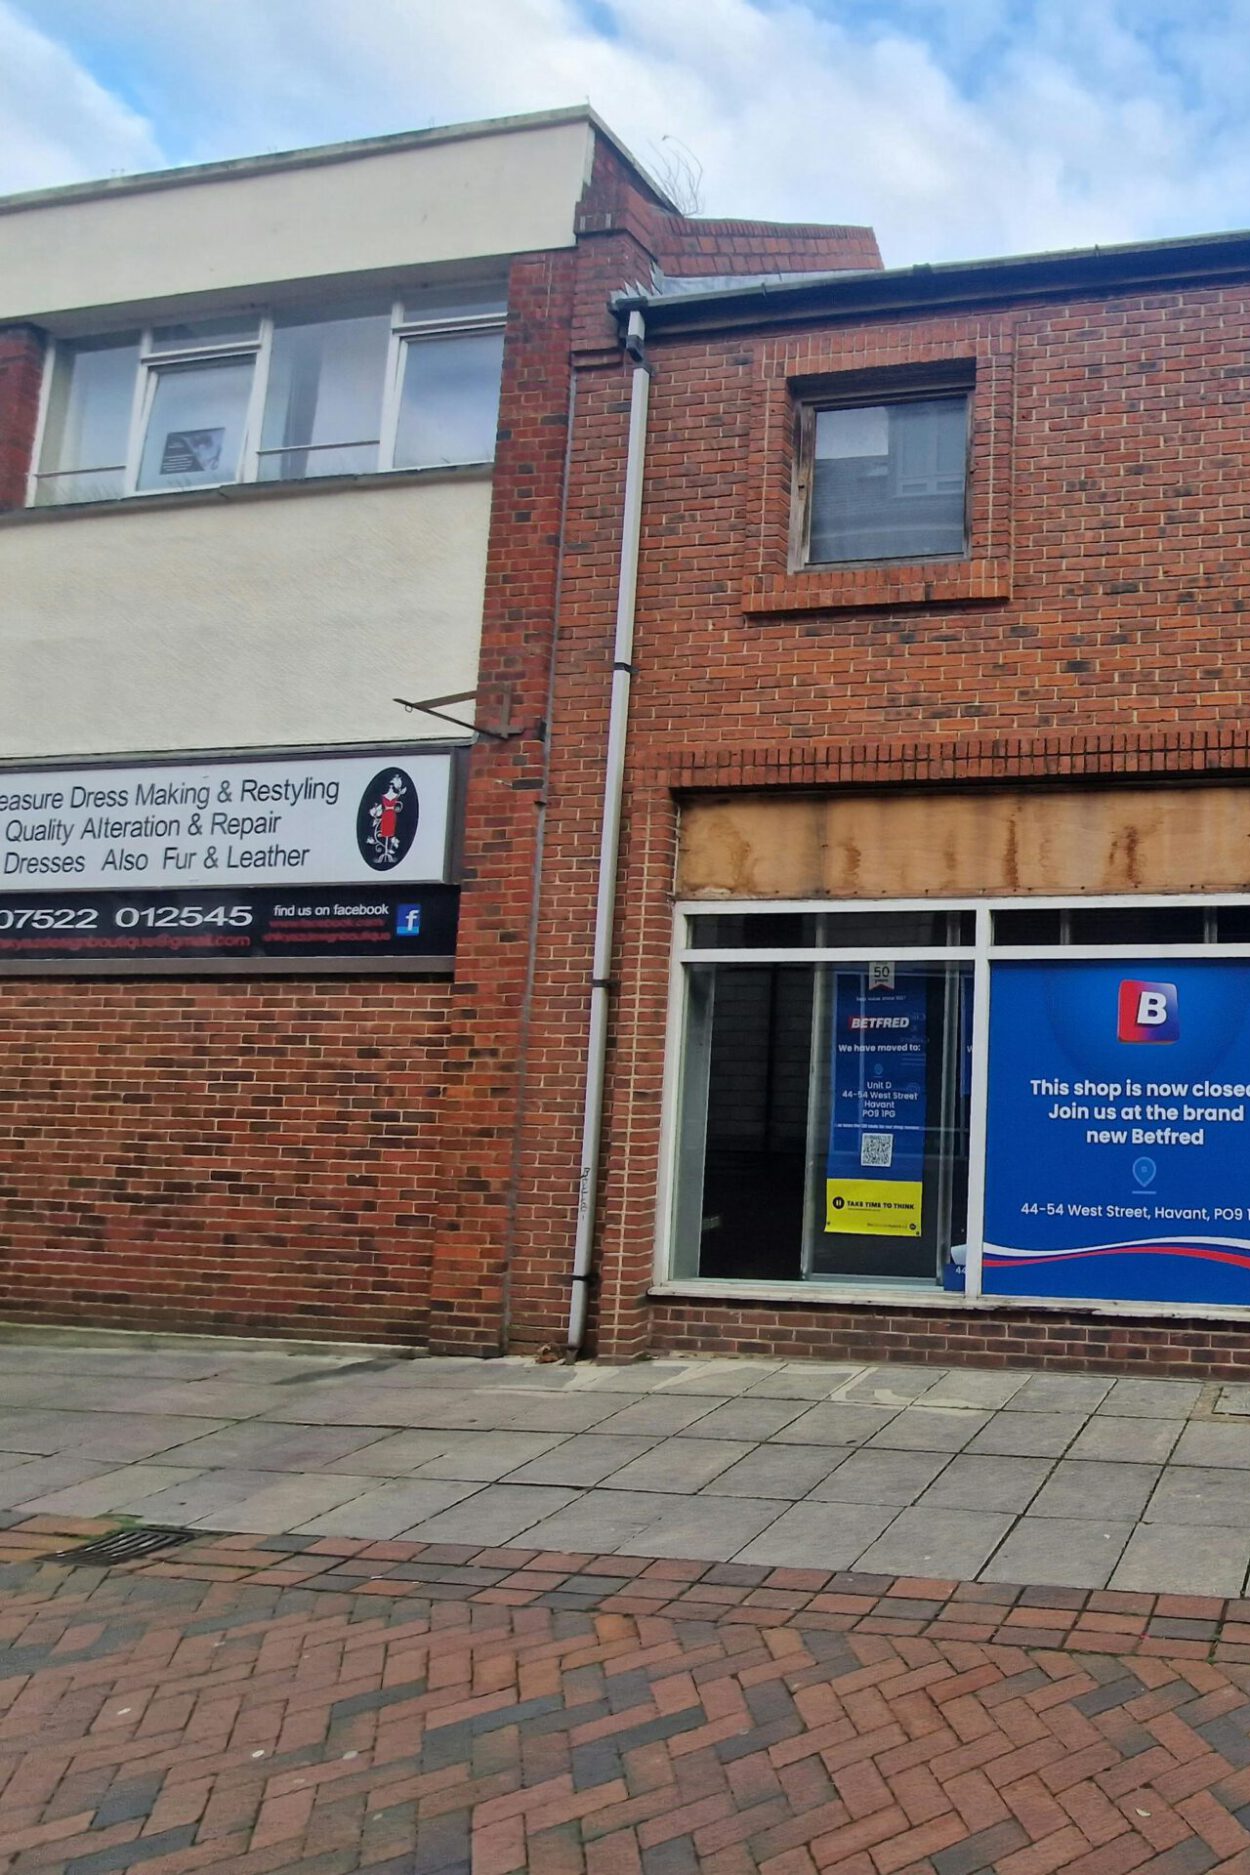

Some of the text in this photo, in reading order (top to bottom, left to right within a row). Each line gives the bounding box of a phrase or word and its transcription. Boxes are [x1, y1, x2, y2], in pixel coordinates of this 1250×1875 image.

[0, 776, 340, 811] easure Dress Making & Restyling
[5, 811, 282, 846] Quality Alteration & Repair
[4, 844, 310, 874] Dresses Also Fur & Leather
[0, 908, 99, 930] 07522
[115, 905, 253, 928] 012545
[273, 903, 389, 917] find us on facebook
[874, 966, 890, 978] 50
[1137, 991, 1168, 1025] B
[851, 1017, 910, 1029] BETFRED
[838, 1043, 921, 1053] We have moved to:
[866, 1081, 892, 1090] Unit D
[1030, 1078, 1070, 1097] This
[1073, 1078, 1122, 1101] shop
[1126, 1078, 1142, 1097] is
[1147, 1083, 1188, 1098] now
[842, 1090, 918, 1101] 44-54 West Street
[864, 1101, 895, 1110] Havant
[1048, 1102, 1245, 1122] Join us at the brand
[862, 1110, 896, 1119] PO9 1PG
[1087, 1128, 1205, 1146] new Betfred
[865, 1201, 882, 1209] TIME
[1020, 1203, 1065, 1216] 44-54
[1067, 1204, 1103, 1218] West
[1106, 1205, 1151, 1220] Street,
[1154, 1207, 1210, 1222] Havant,
[1214, 1208, 1244, 1222] PO9
